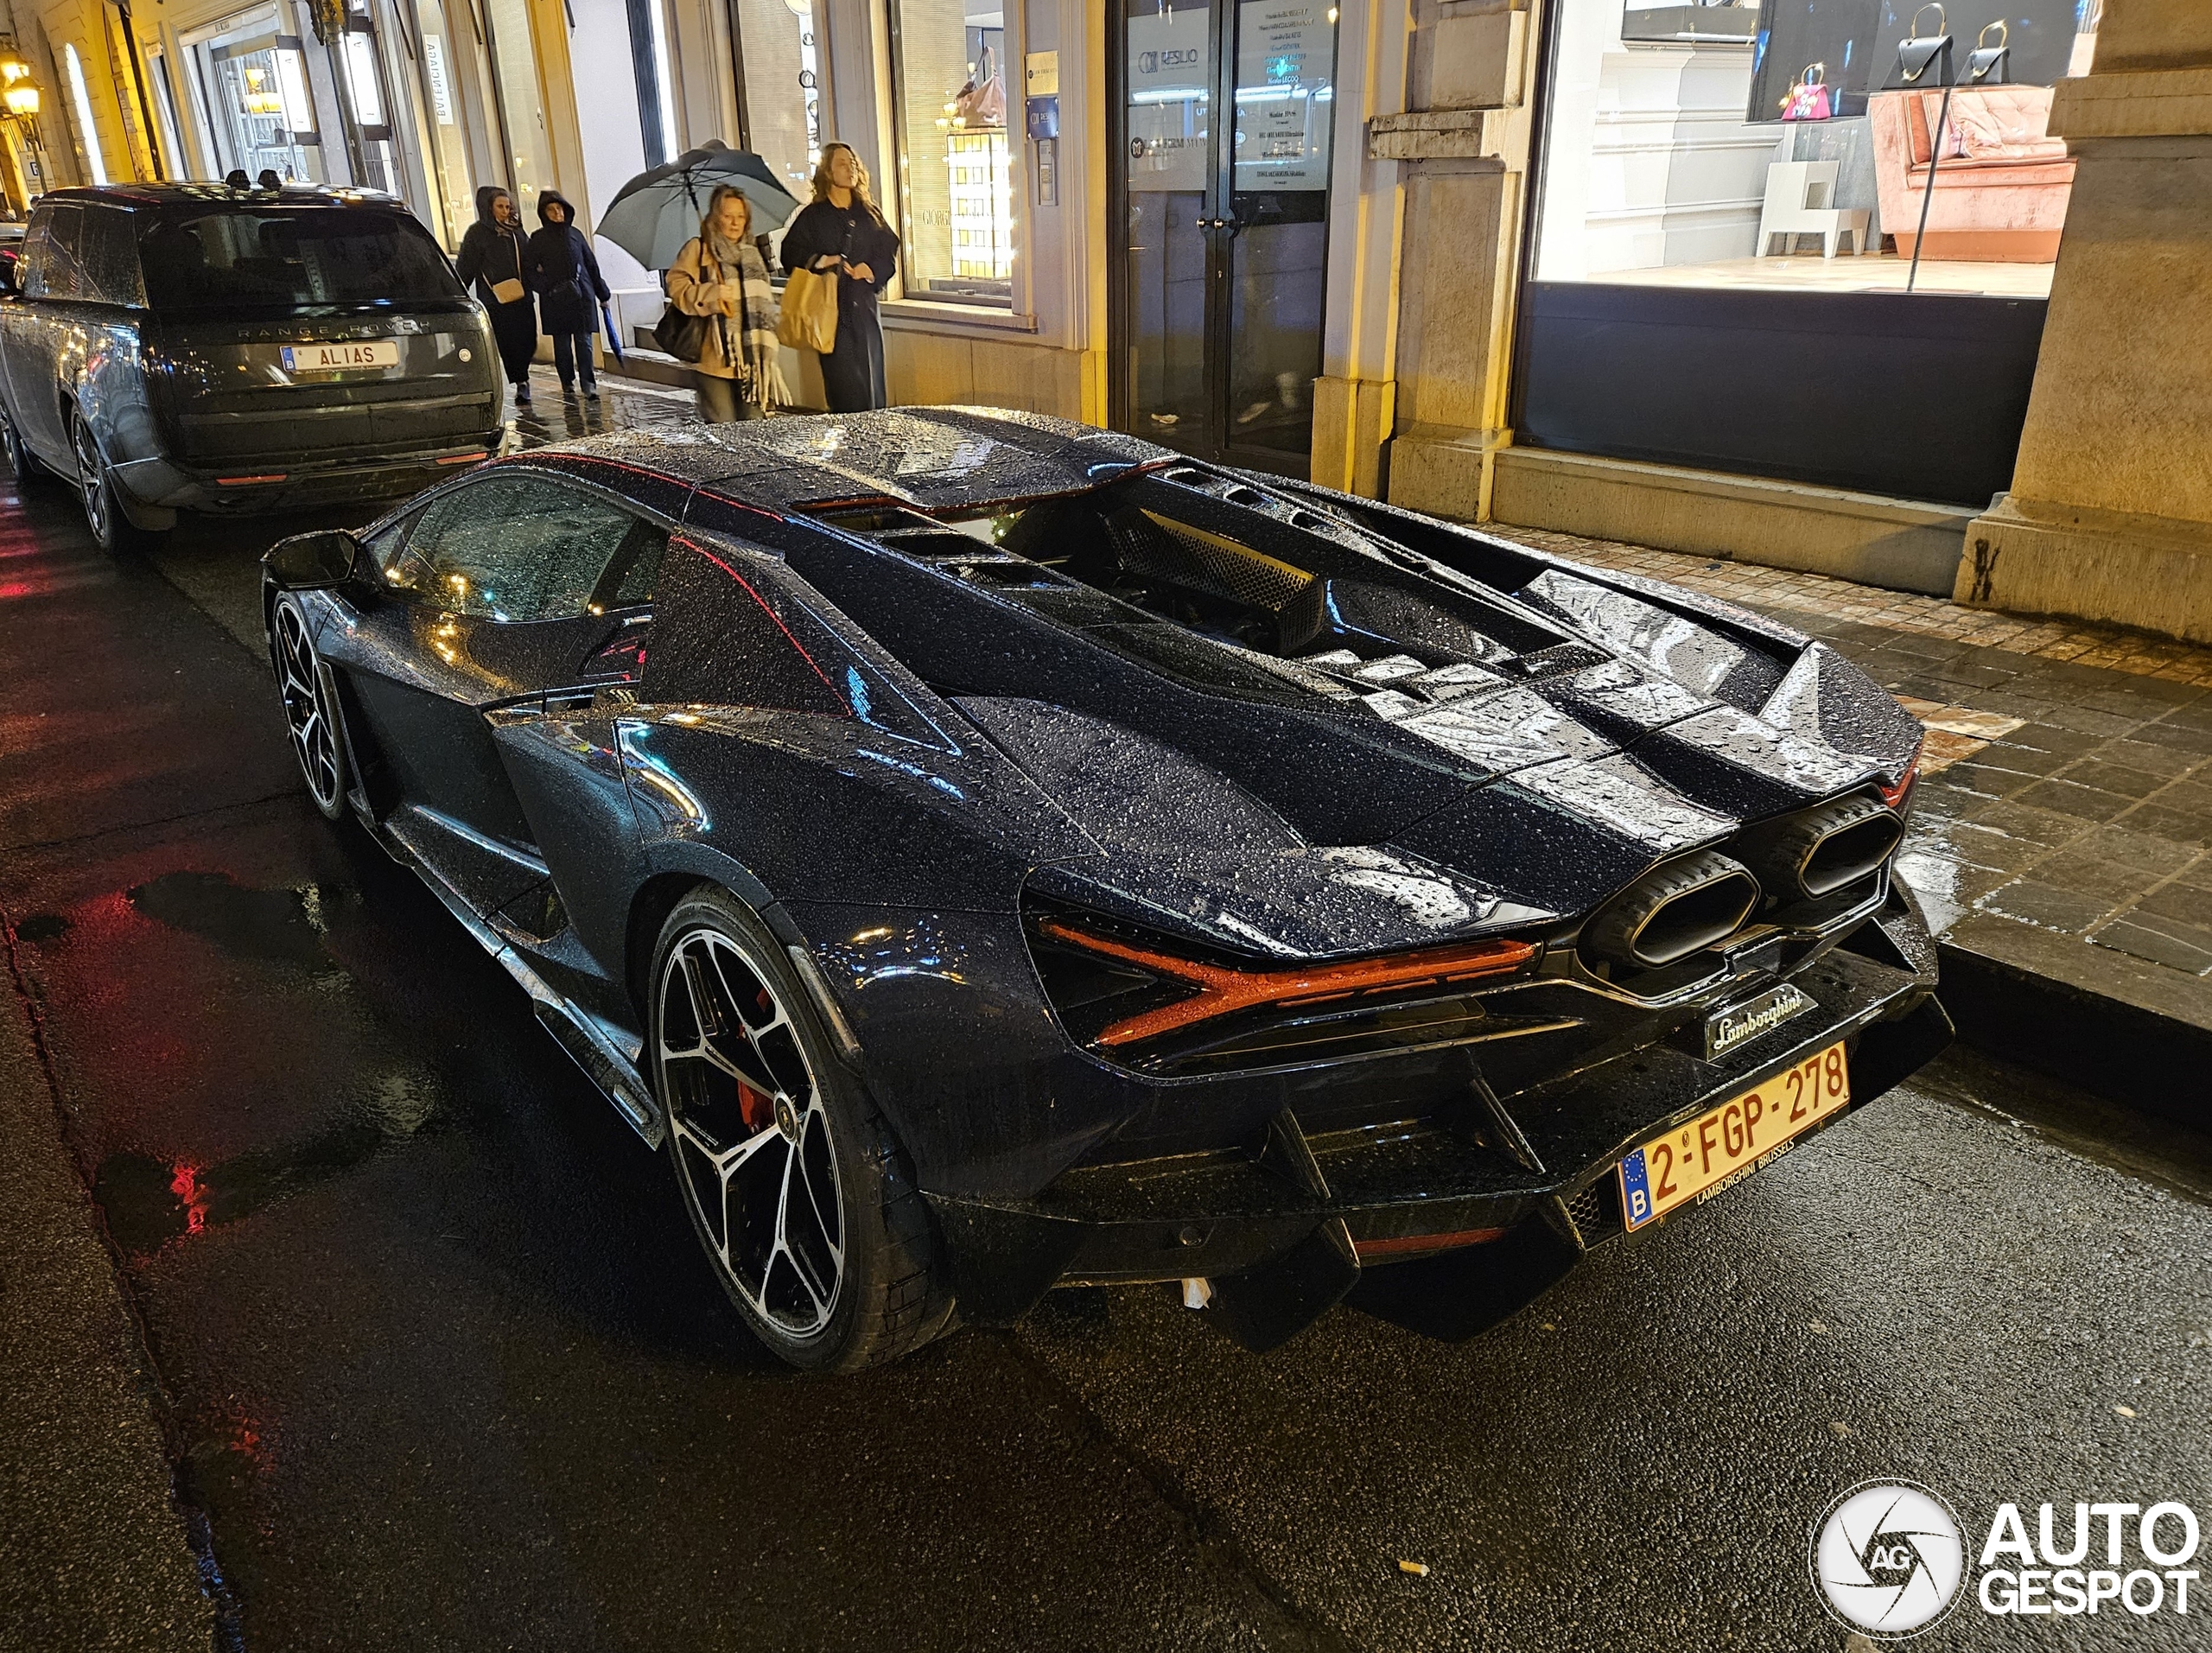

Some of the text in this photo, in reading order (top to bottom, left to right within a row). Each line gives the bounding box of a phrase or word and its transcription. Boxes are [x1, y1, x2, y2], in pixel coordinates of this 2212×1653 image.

[238, 321, 430, 338] RANGE ROVER
[287, 346, 374, 369] B ALIAS
[1713, 990, 1803, 1050] Lamborghini
[1631, 1047, 1844, 1217] B 2-FGP-278
[1696, 1140, 1795, 1205] LAMBORGHINI BRUSSELS
